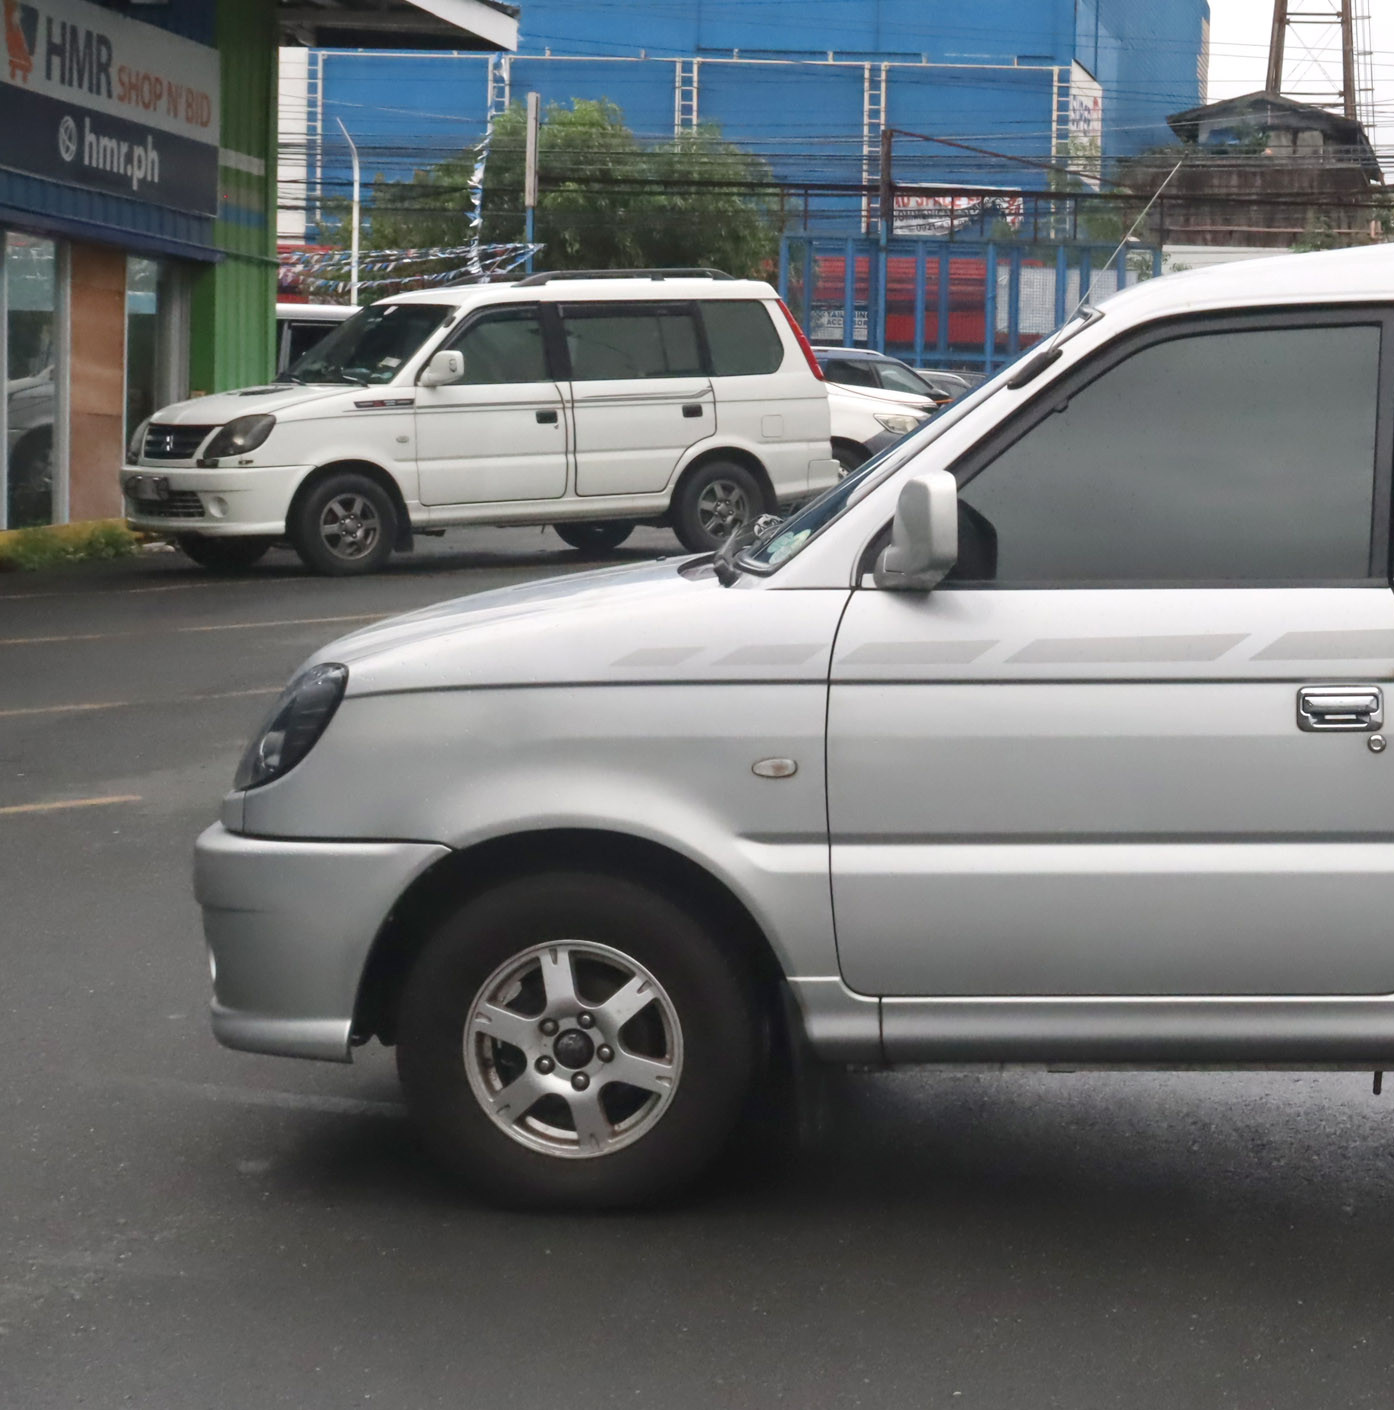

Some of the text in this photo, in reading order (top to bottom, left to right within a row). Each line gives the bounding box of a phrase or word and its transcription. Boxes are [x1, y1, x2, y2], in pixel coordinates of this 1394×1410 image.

[45, 16, 211, 127] HMR SHOP N' BID
[83, 116, 160, 190] hmr.ph
